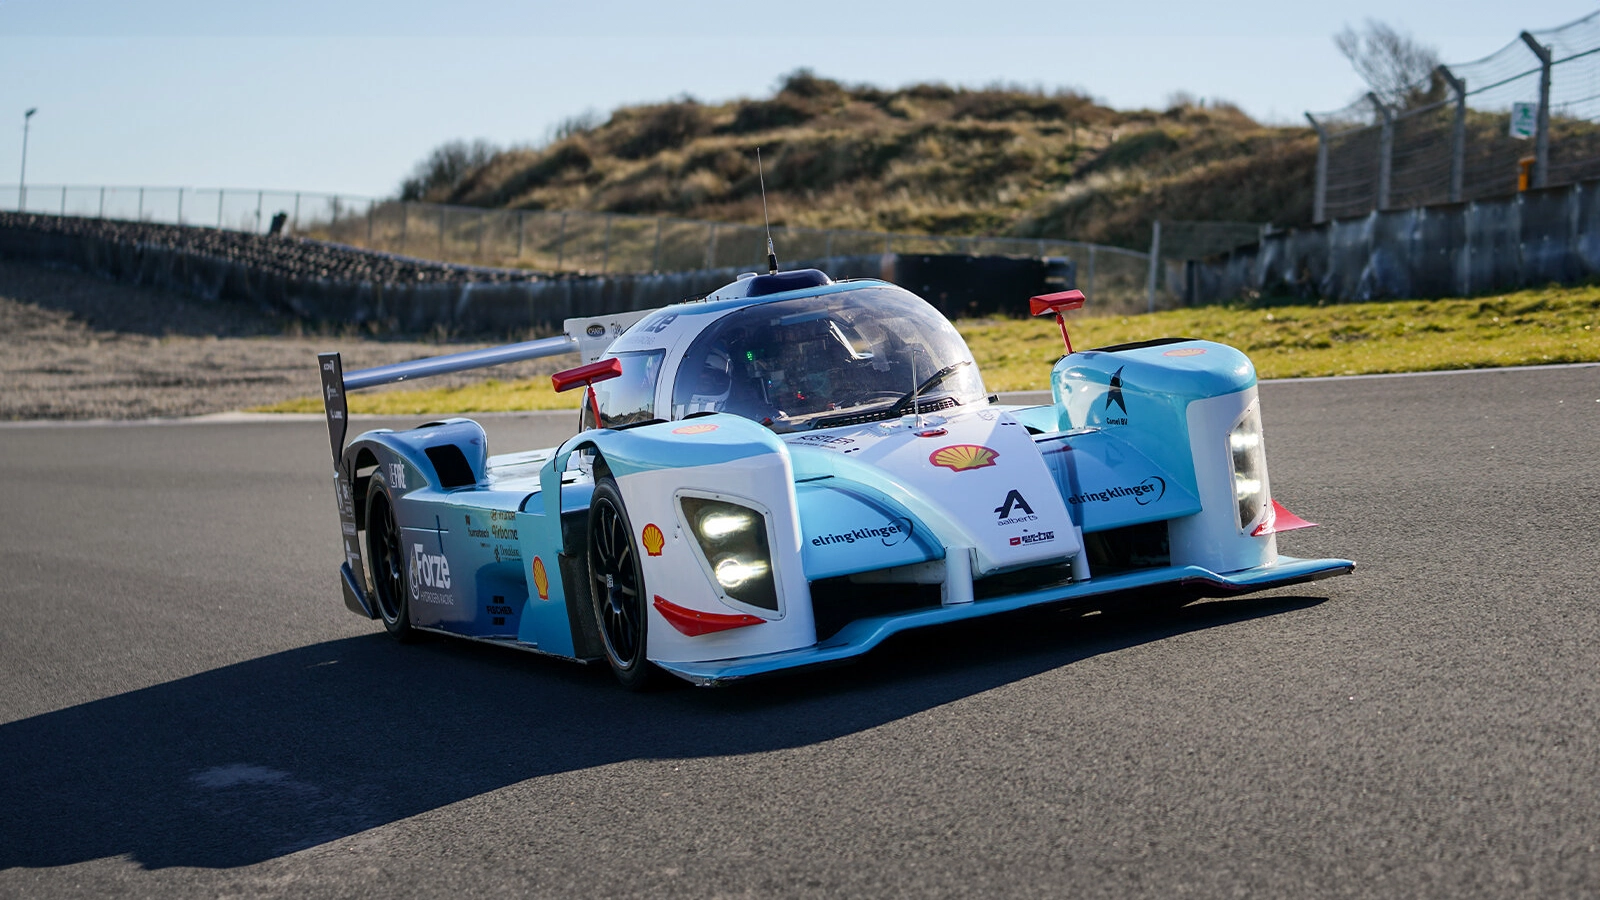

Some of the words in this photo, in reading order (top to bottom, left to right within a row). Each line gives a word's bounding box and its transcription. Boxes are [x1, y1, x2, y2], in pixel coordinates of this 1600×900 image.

[1068, 483, 1155, 505] elringklinger
[997, 515, 1038, 526] aalberts
[811, 524, 902, 547] elringklinger
[413, 543, 451, 589] Forze
[486, 605, 513, 615] FISCHER
